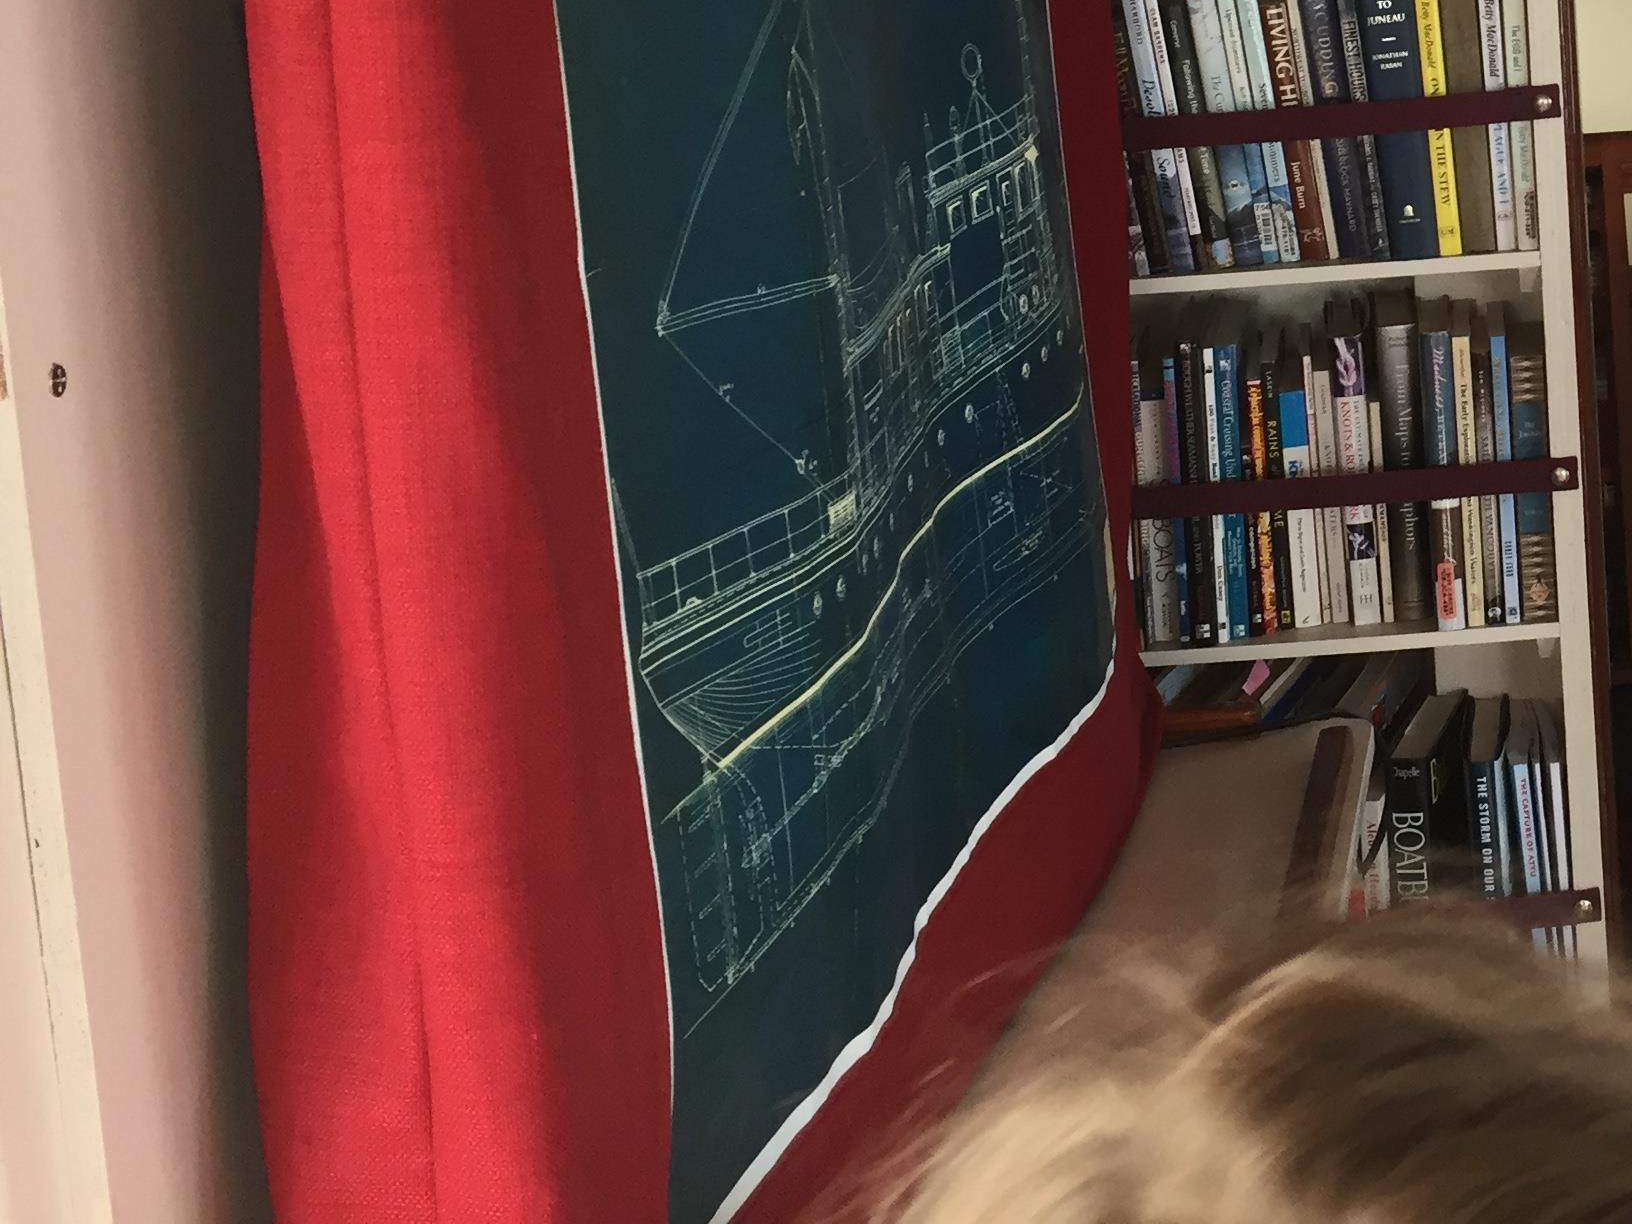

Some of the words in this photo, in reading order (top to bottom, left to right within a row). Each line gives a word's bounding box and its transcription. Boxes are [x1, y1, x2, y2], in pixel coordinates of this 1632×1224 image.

[1366, 12, 1407, 27] JUNEAU
[1376, 0, 1394, 10] TO
[1266, 8, 1294, 78] LIVING
[1343, 21, 1361, 60] FINEST
[1486, 24, 1501, 78] MacDonald
[1141, 79, 1162, 116] Desol
[1279, 84, 1299, 107] HI
[1348, 63, 1367, 102] HOURS
[1290, 162, 1304, 183] June
[1435, 145, 1449, 169] THE
[1295, 186, 1308, 209] Burn
[1437, 171, 1452, 206] STEW
[1394, 364, 1411, 404] From
[1340, 401, 1355, 441] KNOTS
[1392, 408, 1413, 448] Maps
[1266, 420, 1280, 459] RAINS
[1344, 454, 1356, 473] RO
[1273, 510, 1286, 528] ME
[1399, 502, 1421, 551] phors
[1476, 777, 1488, 798] THE
[1520, 778, 1529, 796] THE
[1479, 804, 1492, 844] STORM
[1521, 798, 1533, 838] CAPTURE
[1392, 812, 1429, 903] BOATB
[1481, 848, 1494, 864] ON
[1526, 841, 1534, 852] OF
[1483, 869, 1496, 892] OUR
